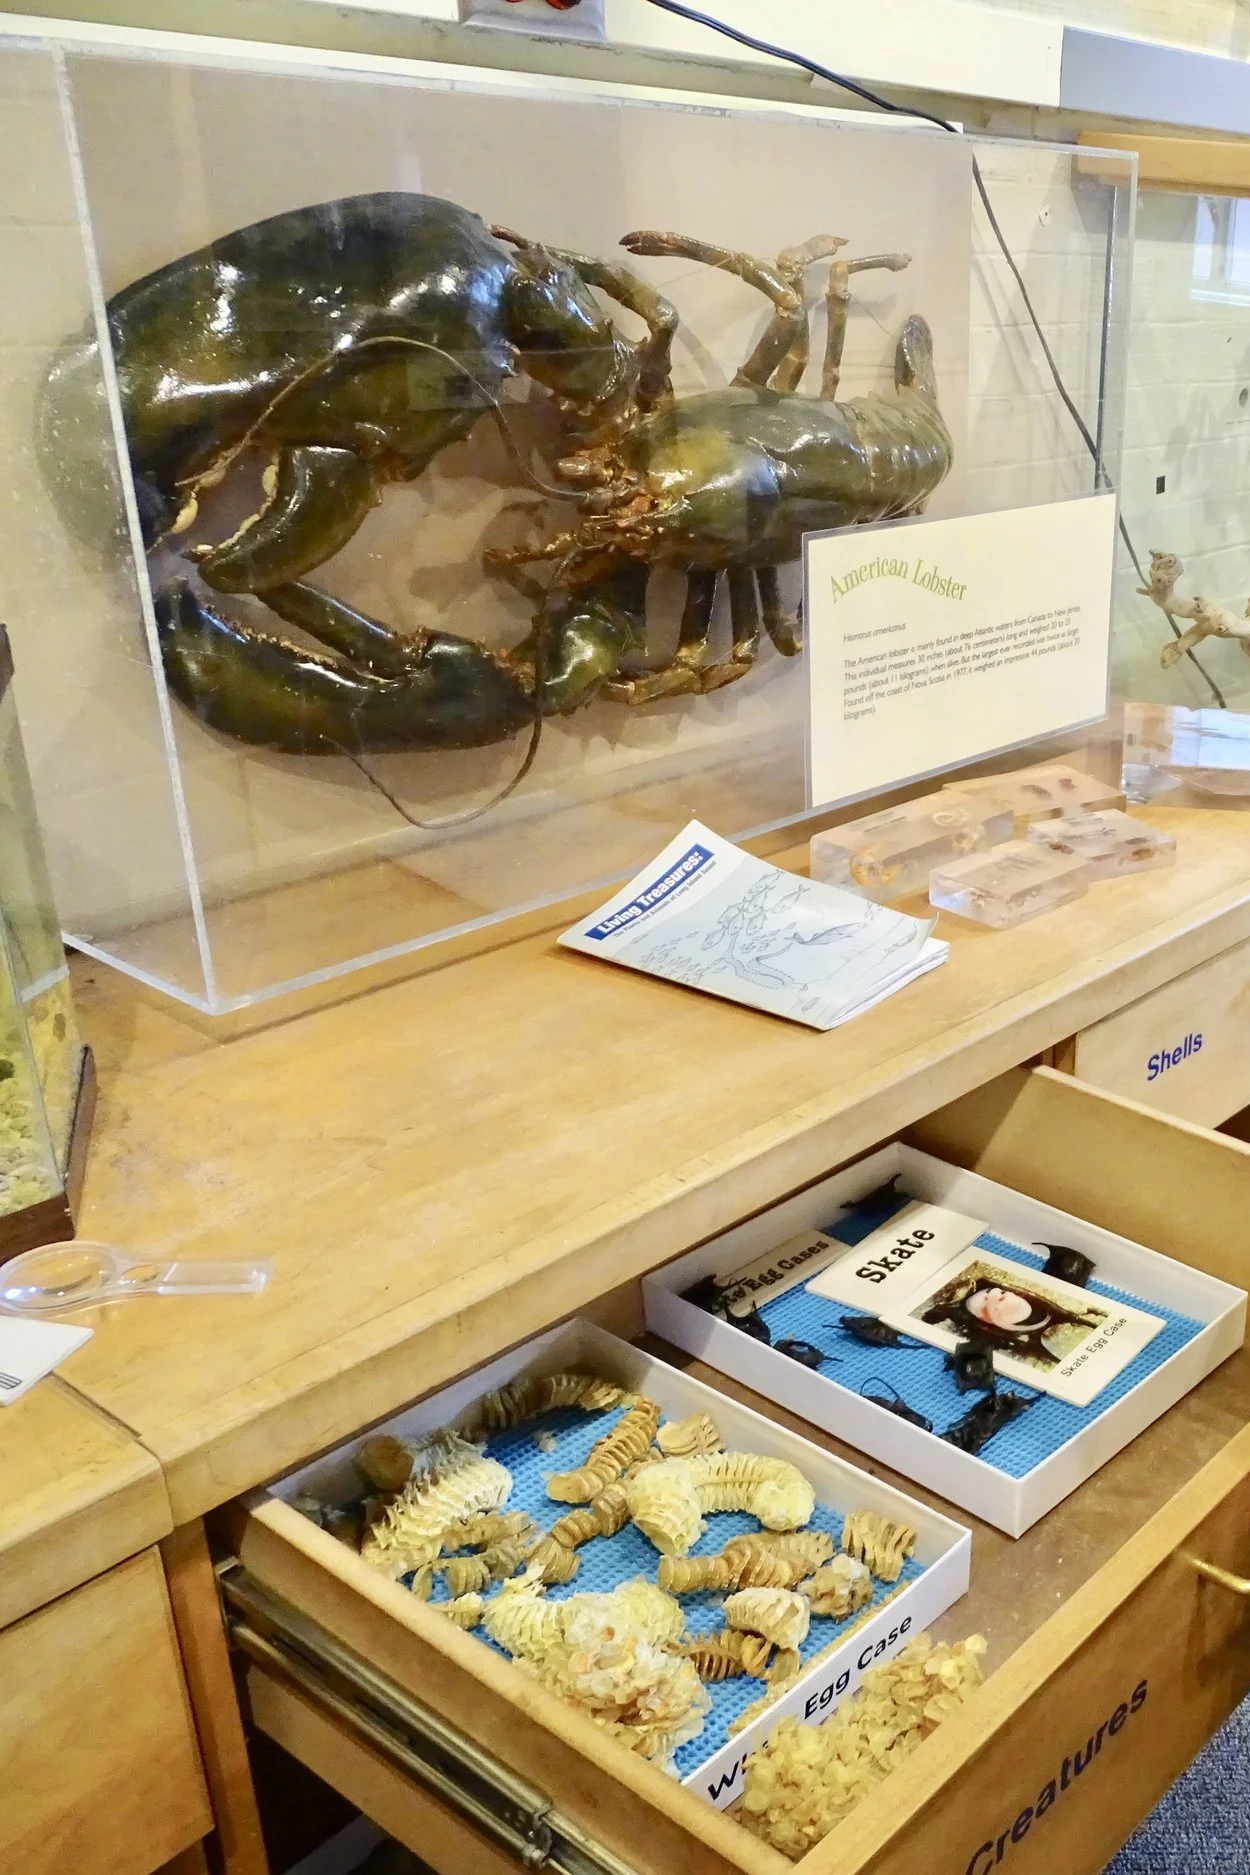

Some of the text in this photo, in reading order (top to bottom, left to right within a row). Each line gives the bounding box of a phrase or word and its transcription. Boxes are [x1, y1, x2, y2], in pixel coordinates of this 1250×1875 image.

[830, 556, 967, 604] American Lobster
[843, 683, 867, 697] pounds
[869, 677, 889, 690] (about
[891, 674, 898, 682] 11
[899, 667, 929, 680] kilograms)
[930, 663, 945, 672] when
[961, 656, 970, 664] But
[972, 653, 980, 661] the
[982, 648, 998, 660] largest
[1012, 639, 1035, 651] recorded
[1036, 637, 1046, 645] was
[1047, 633, 1060, 641] twice
[844, 660, 856, 668] The
[857, 653, 887, 665] American
[889, 647, 909, 658] lobster
[917, 640, 934, 651] mainly
[936, 636, 952, 646] found
[953, 634, 958, 642] in
[960, 632, 973, 641] deep
[974, 626, 994, 636] Atlantic
[995, 622, 1012, 631] waters
[1014, 618, 1027, 627] from
[1027, 613, 1046, 624] Canada
[1054, 608, 1066, 617] New
[844, 673, 857, 681] This
[858, 664, 887, 678] individual
[888, 659, 915, 671] measures
[926, 650, 943, 661] inches
[945, 646, 962, 658] (about
[965, 643, 971, 651] 76
[1006, 632, 1017, 642] long
[1018, 629, 1028, 638] and
[1029, 623, 1050, 635] weighed
[1051, 621, 1057, 629] 20
[843, 697, 863, 708] Found
[865, 692, 874, 702] off
[875, 691, 885, 700] the
[887, 687, 902, 697] coast
[904, 683, 911, 692] of
[911, 680, 927, 690] Nova
[929, 674, 945, 685] Scotia
[974, 660, 995, 672] weighed
[1004, 652, 1030, 664] impressive
[1038, 644, 1056, 657] pounds
[1058, 639, 1073, 651] (about
[1074, 636, 1081, 645] 20
[596, 851, 704, 933] Living Treasures:
[676, 885, 689, 897] Long
[1147, 1032, 1202, 1081] Shells
[742, 1239, 831, 1291] Egg Cases
[855, 1227, 936, 1284] Skate
[1061, 1318, 1127, 1377] Skate Egg Case
[804, 1616, 912, 1720] Egg Case
[965, 1679, 1148, 1875] Creatures
